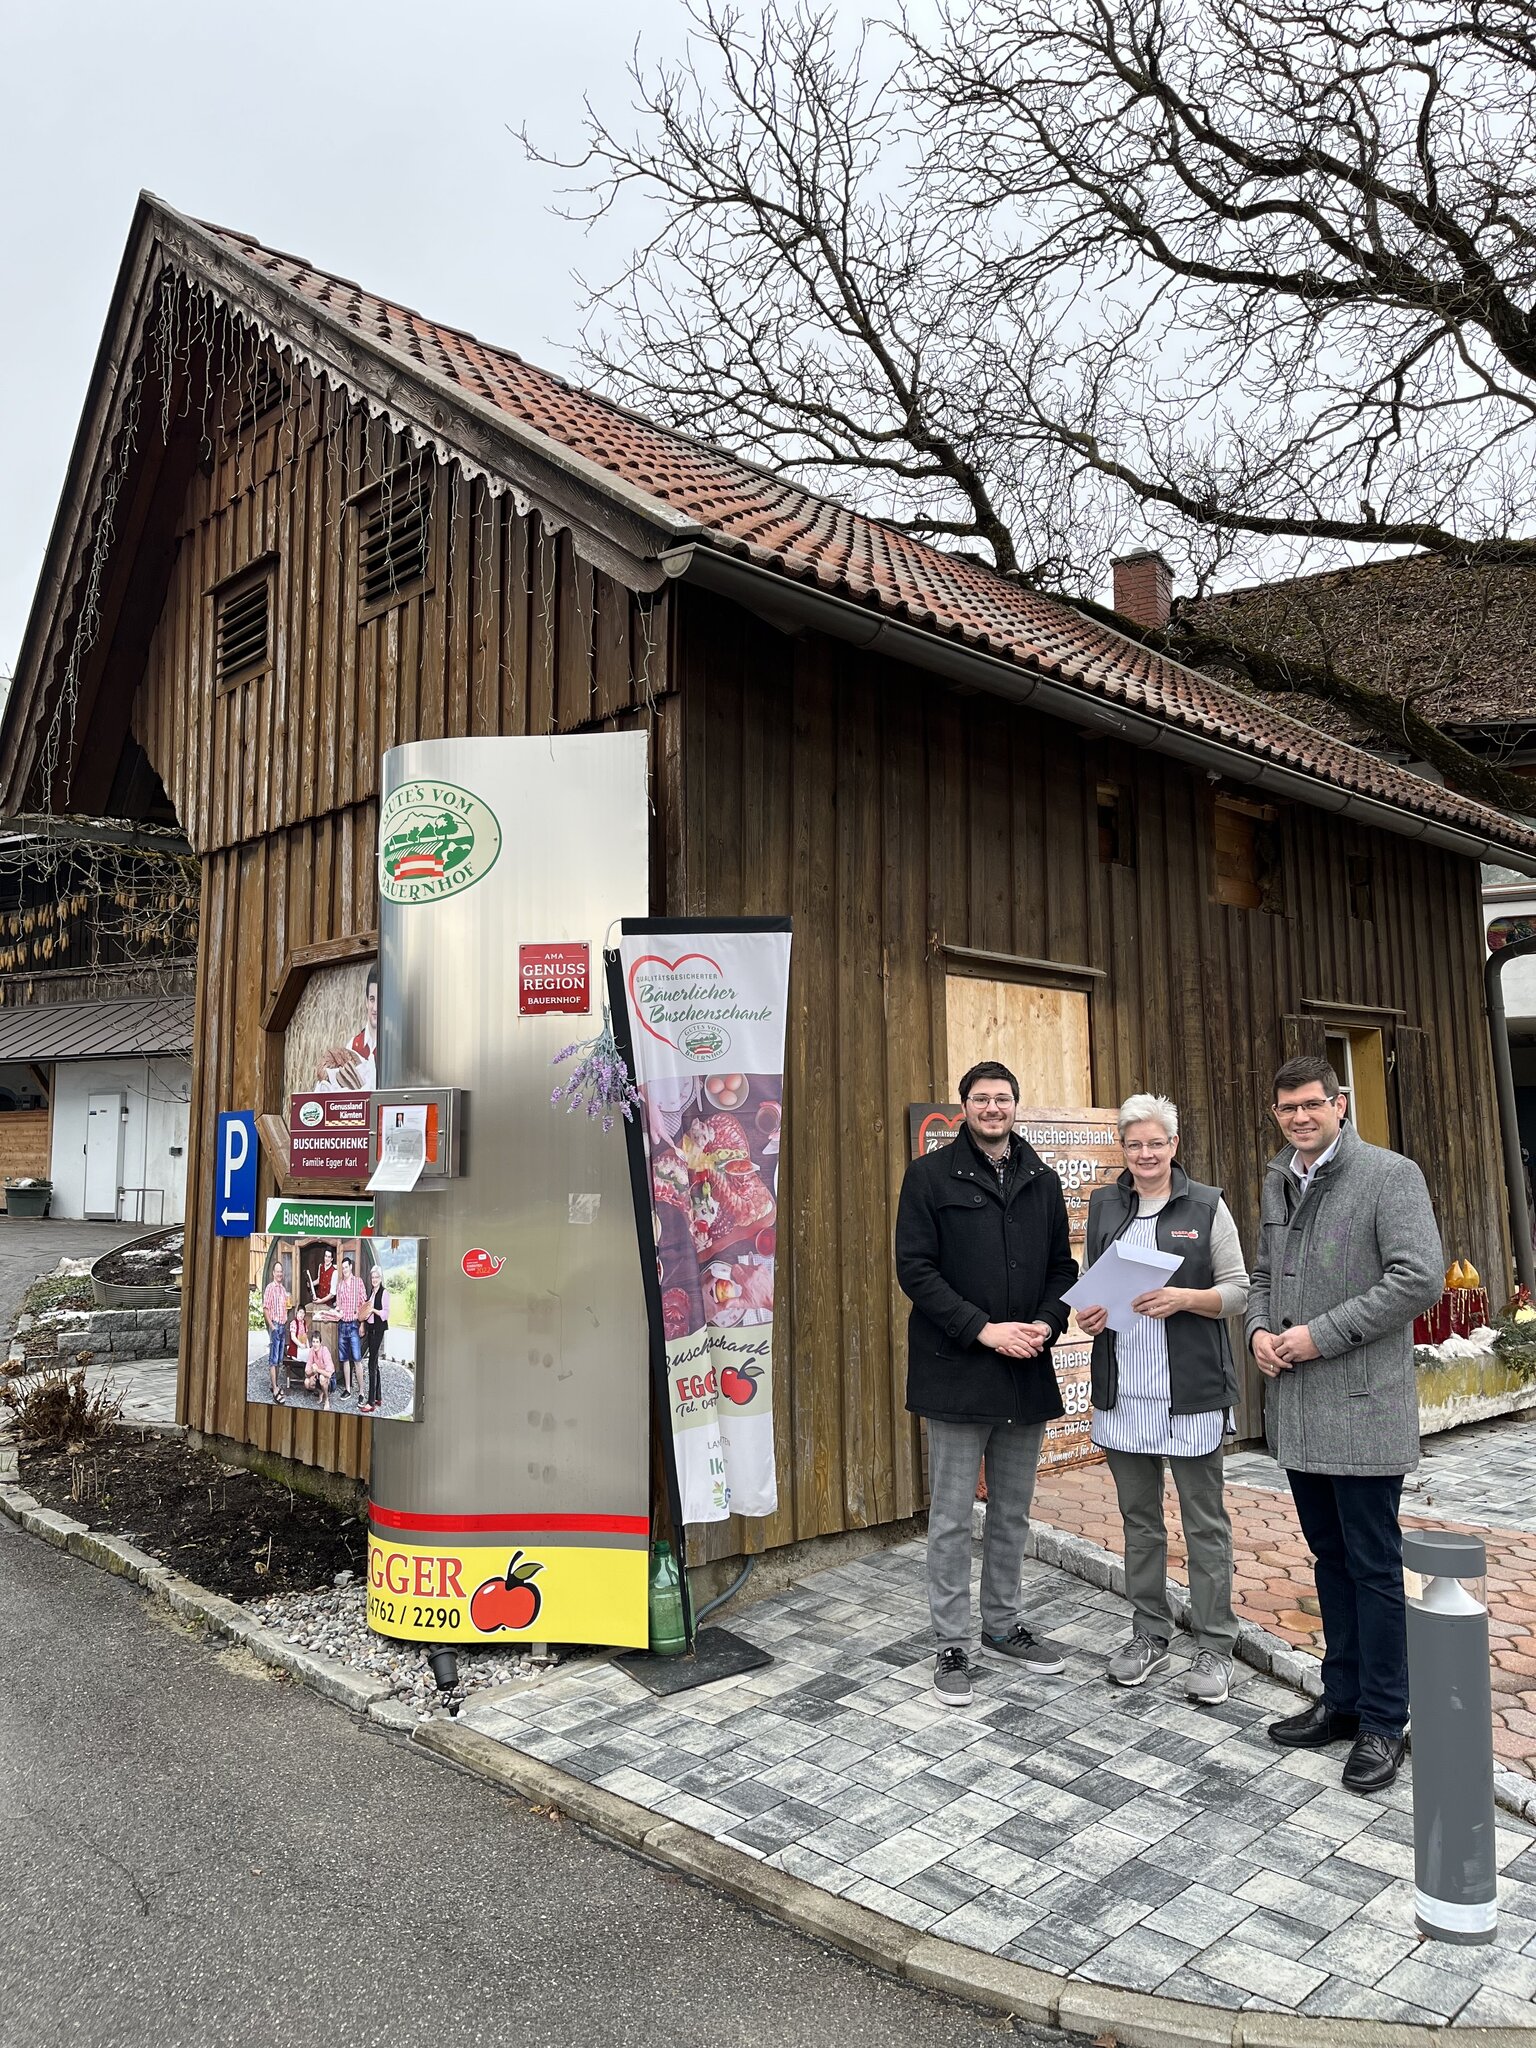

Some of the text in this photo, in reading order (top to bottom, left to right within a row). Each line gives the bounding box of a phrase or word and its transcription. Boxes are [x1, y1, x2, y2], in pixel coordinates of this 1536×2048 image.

[432, 788, 474, 815] VOM
[523, 963, 585, 976] GENUSS
[523, 977, 585, 990] REGION
[636, 973, 718, 983] QUALITÄTSGESICHERTER
[527, 996, 581, 1005] BAUERNHOF
[639, 983, 737, 1004] Bäuerlicher
[649, 1004, 772, 1023] Buschenschank
[330, 1102, 363, 1111] Genussland
[1019, 1125, 1115, 1145] Buschenschank
[293, 1137, 369, 1150] BUSCHENSCHENKE
[225, 1119, 249, 1198] P
[302, 1157, 358, 1169] Familie Egger Karl
[1063, 1197, 1082, 1208] 762
[283, 1208, 351, 1229] Buschenschank
[675, 1401, 698, 1417] Tel.
[1064, 1420, 1090, 1436] 04762
[368, 1545, 467, 1598] GGER
[413, 1606, 461, 1628] 2290
